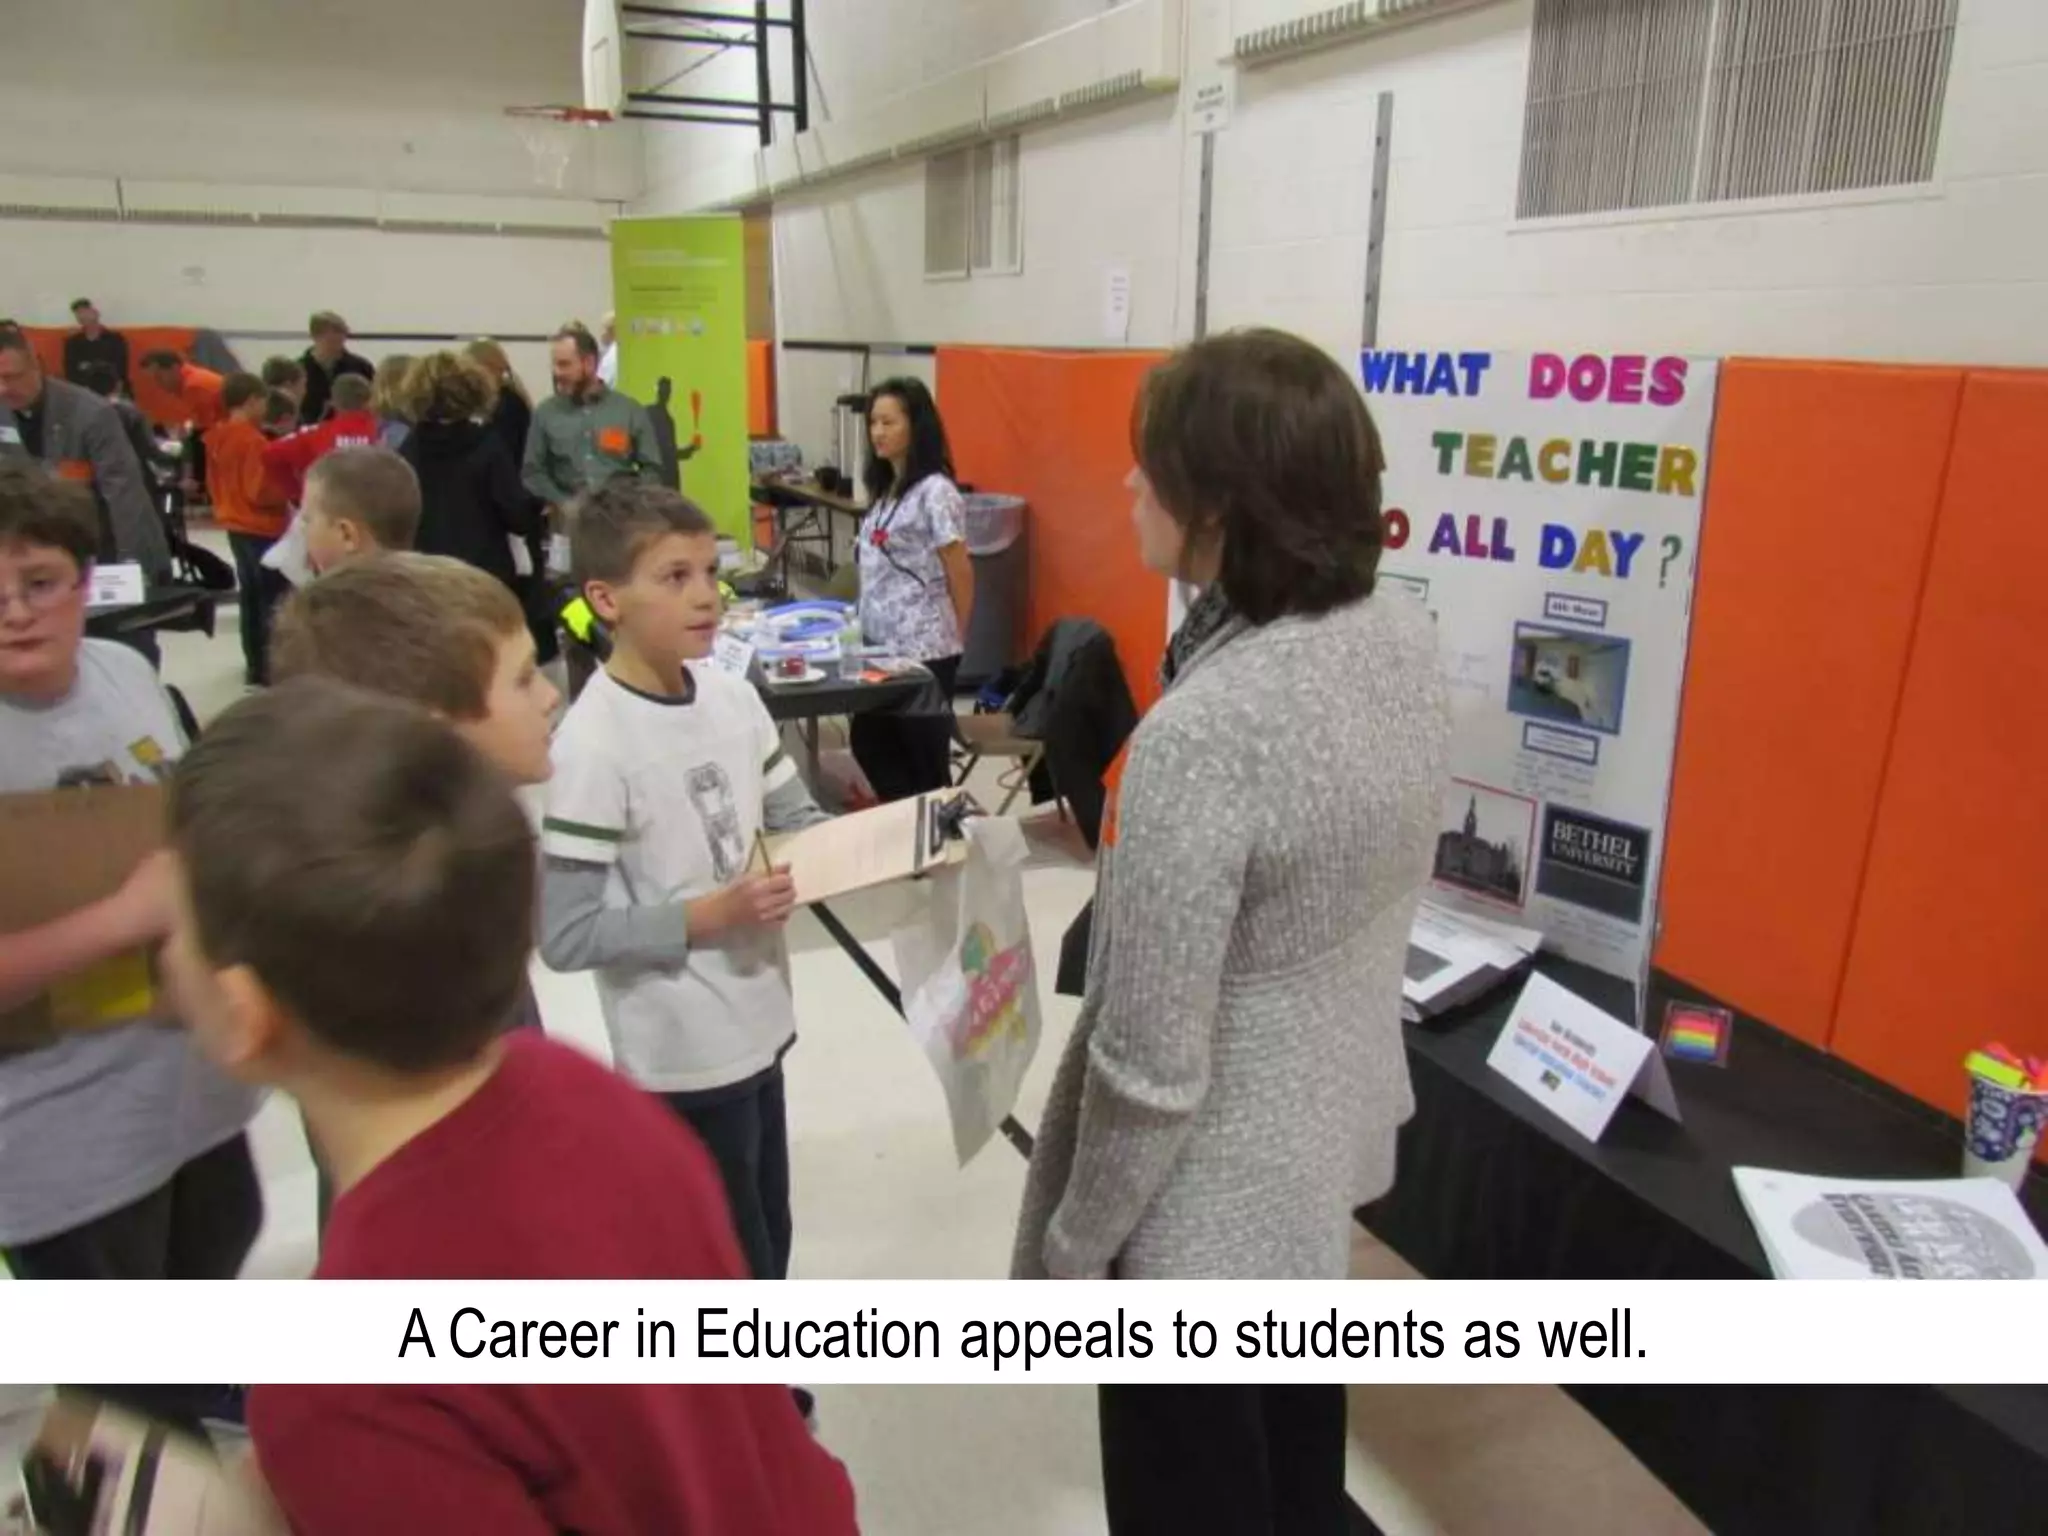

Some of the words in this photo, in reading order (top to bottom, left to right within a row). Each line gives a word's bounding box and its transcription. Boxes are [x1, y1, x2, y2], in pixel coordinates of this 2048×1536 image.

[1361, 351, 1491, 397] WHAT
[1528, 353, 1688, 407] DOES
[1432, 430, 1697, 497] TEACHER
[1381, 508, 1410, 551] O
[1428, 513, 1515, 562] ALL
[1539, 523, 1644, 579] DAY
[1658, 534, 1683, 589] ?
[1552, 842, 1636, 876] UNIVERSITY
[1553, 820, 1638, 862] BETHEL
